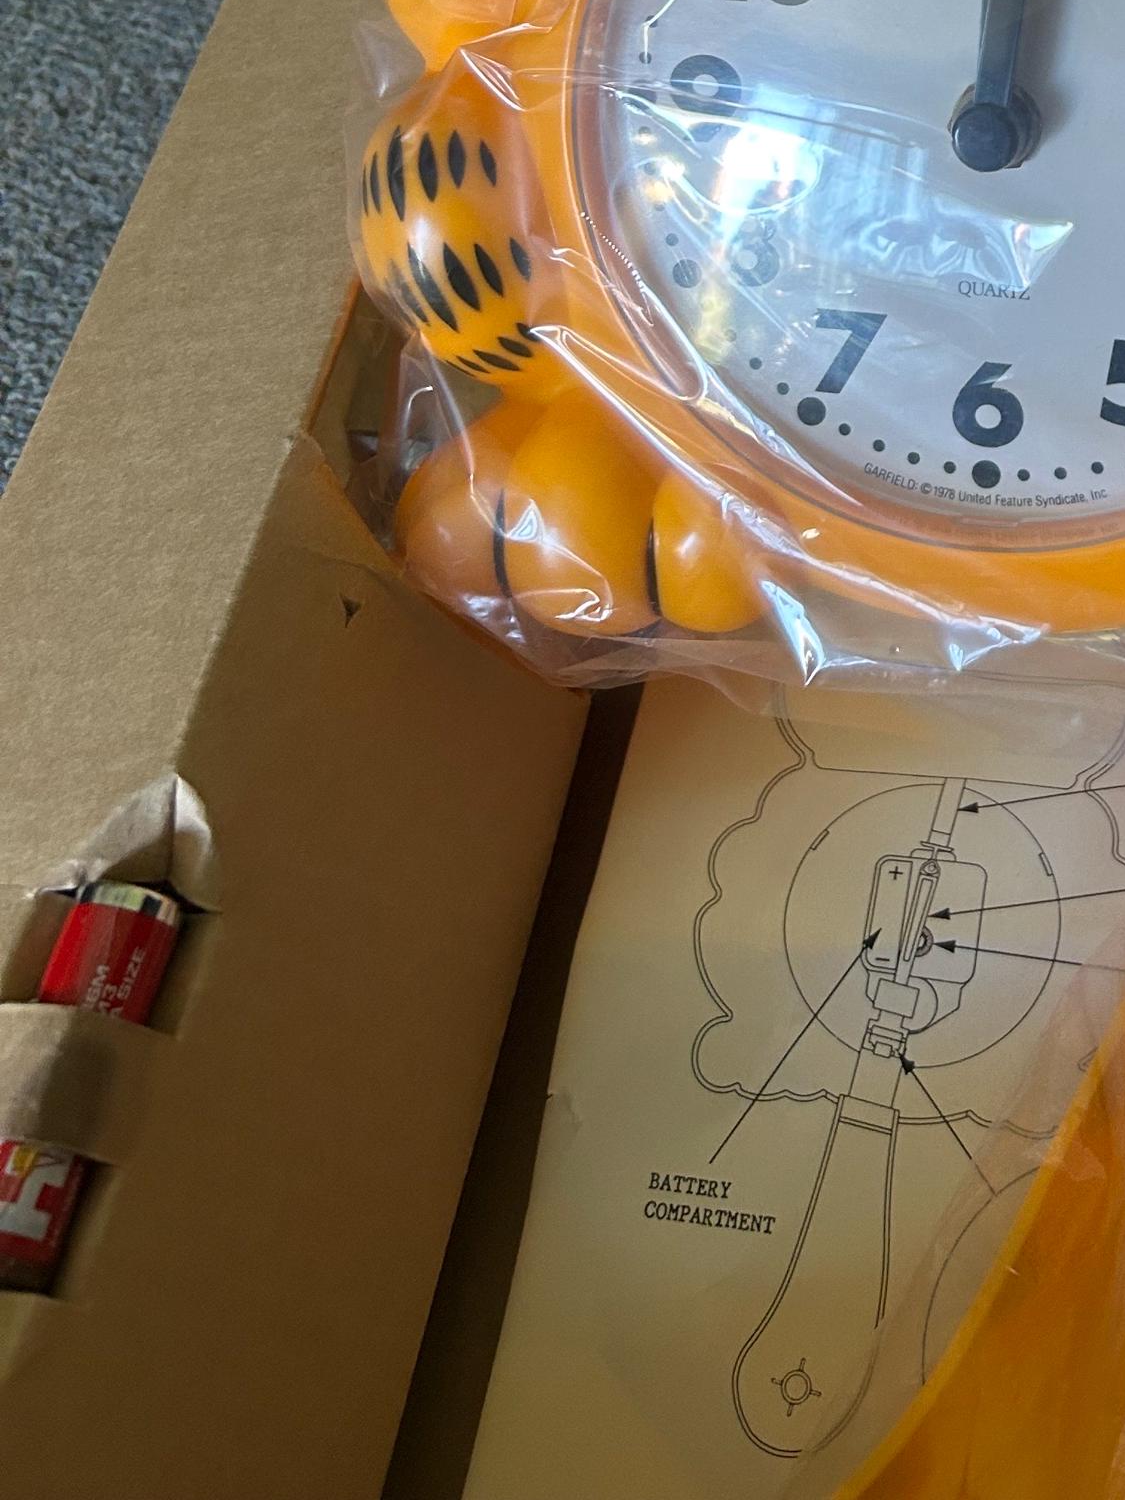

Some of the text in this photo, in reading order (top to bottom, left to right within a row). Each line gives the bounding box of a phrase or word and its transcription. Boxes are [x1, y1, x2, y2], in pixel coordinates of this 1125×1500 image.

[957, 280, 1031, 301] QUARTZ
[814, 308, 888, 393] 7
[952, 361, 1024, 448] 6
[958, 490, 992, 505] United
[995, 493, 1033, 508] Feature
[116, 946, 147, 1000] SIZE
[648, 1172, 732, 1199] BATTERY
[643, 1200, 777, 1235] COMPARTMENT
